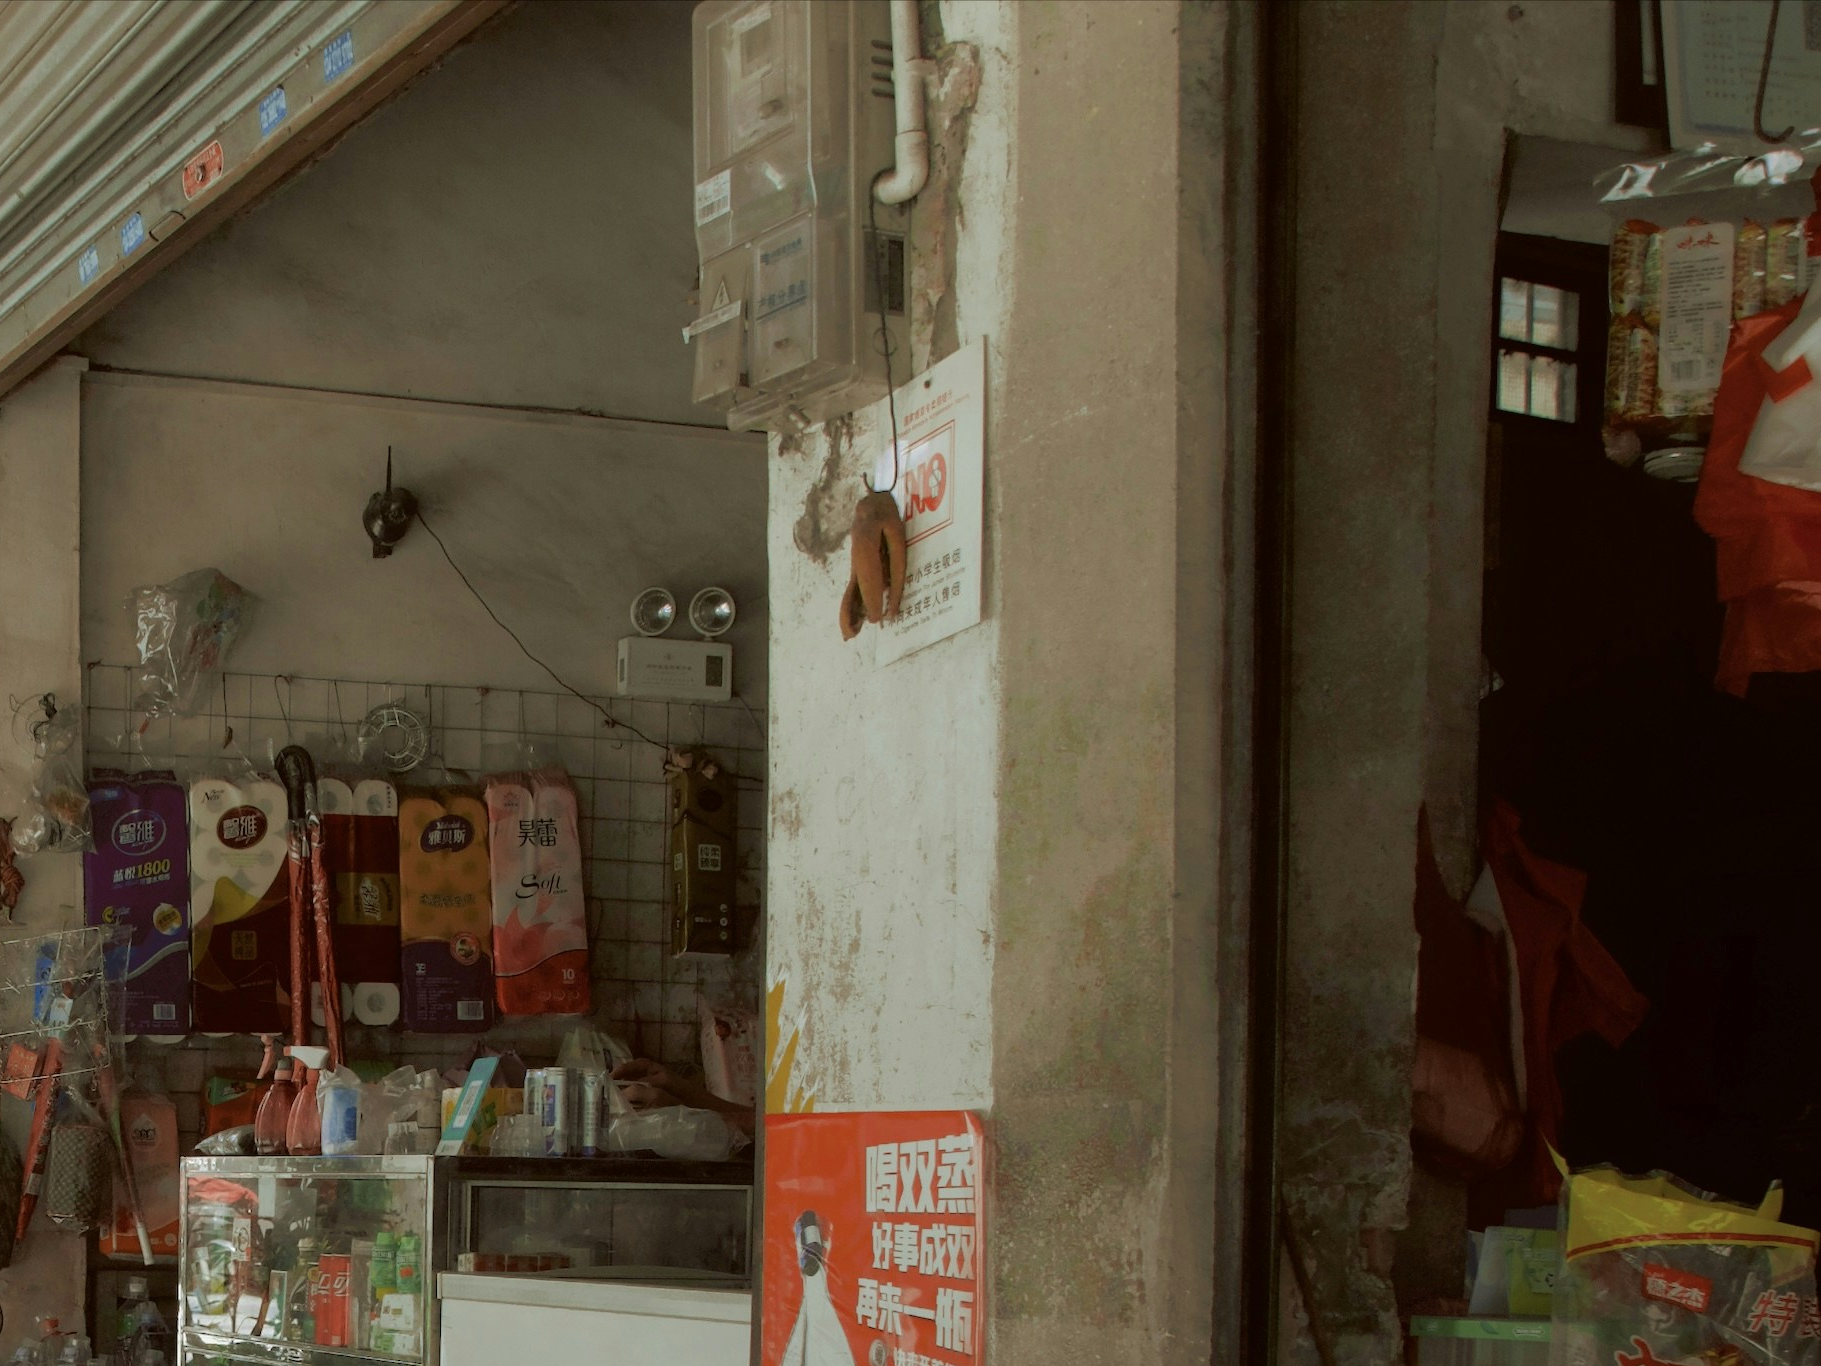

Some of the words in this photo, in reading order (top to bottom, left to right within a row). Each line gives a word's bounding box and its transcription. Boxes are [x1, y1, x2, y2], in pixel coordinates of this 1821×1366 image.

[905, 452, 947, 521] NO
[517, 818, 558, 848] 昊蕾
[516, 873, 561, 898] Soft
[562, 969, 575, 981] 10
[866, 1133, 976, 1214] 喝双蒸
[872, 1221, 976, 1280] 好事成双
[856, 1278, 974, 1355] 再来一瓶
